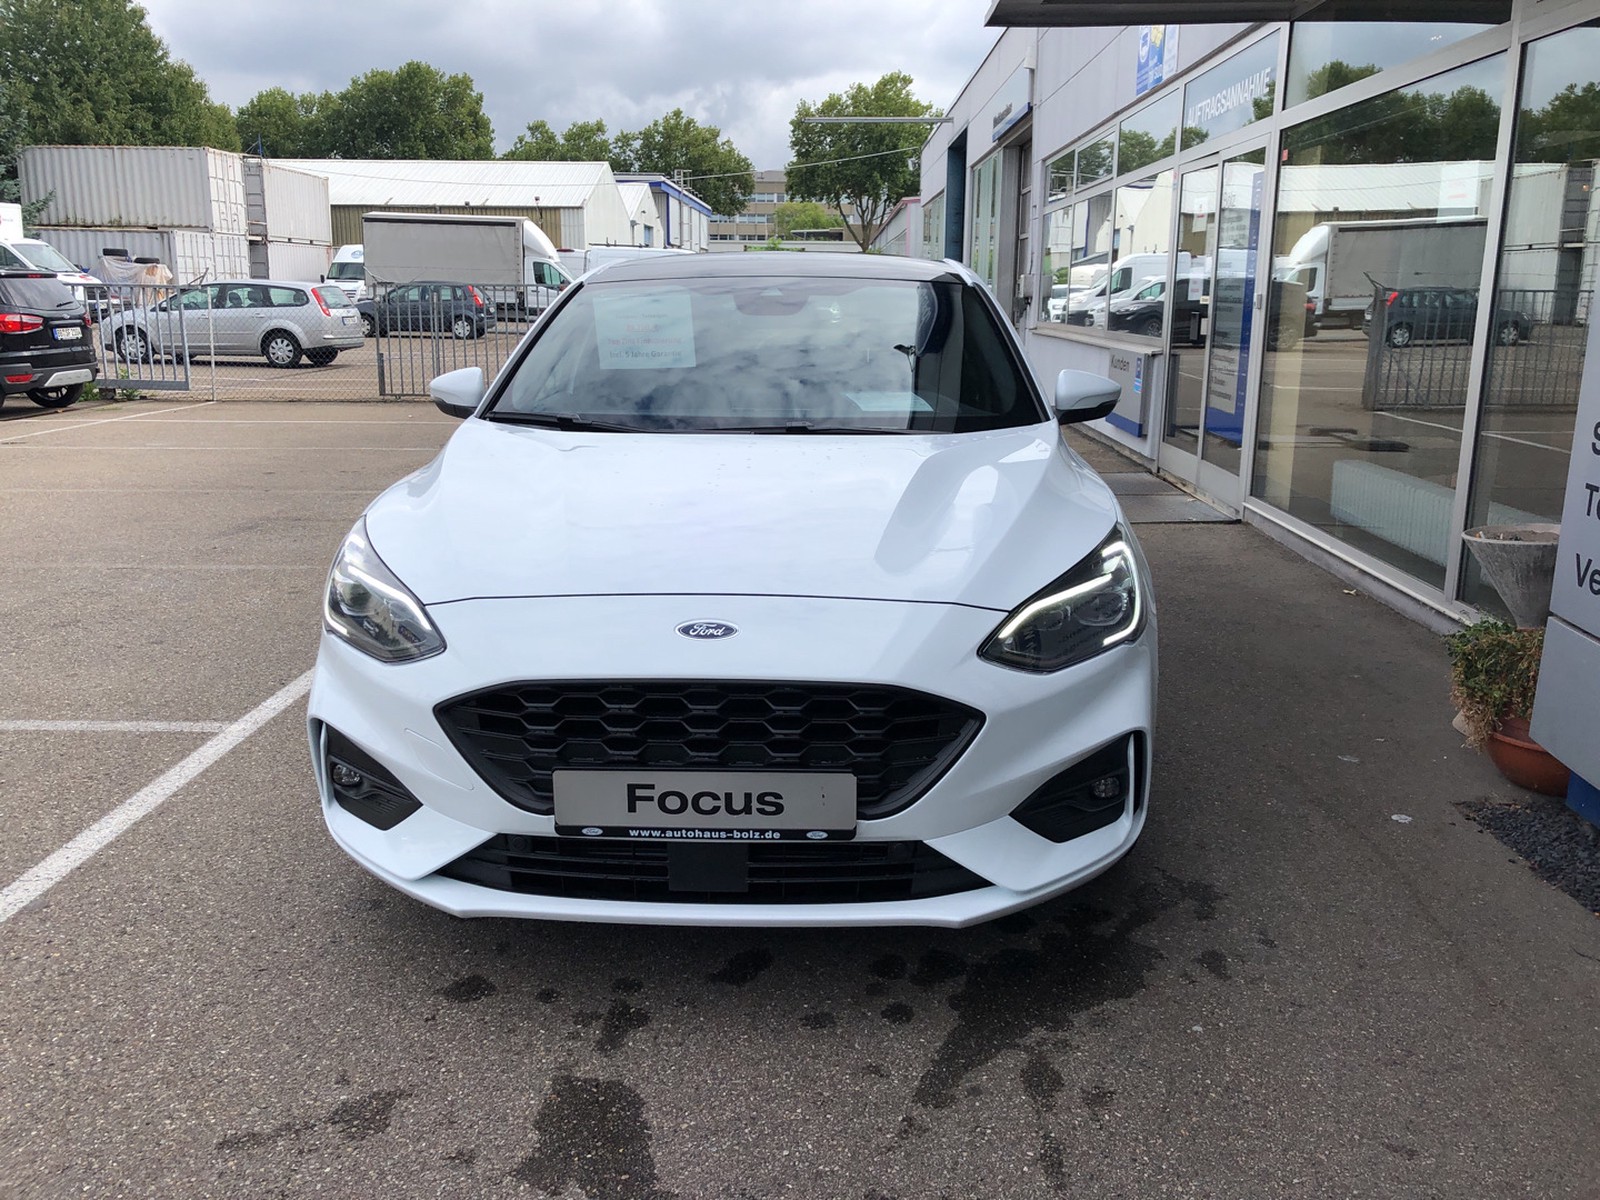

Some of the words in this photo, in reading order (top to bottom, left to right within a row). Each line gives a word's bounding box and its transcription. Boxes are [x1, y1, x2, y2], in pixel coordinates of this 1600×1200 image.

[1187, 67, 1272, 127] AUFTRAGSANNAHME
[688, 622, 726, 636] Ford
[626, 783, 785, 817] Focus
[628, 827, 781, 840] www.autohaus-bolz.de
